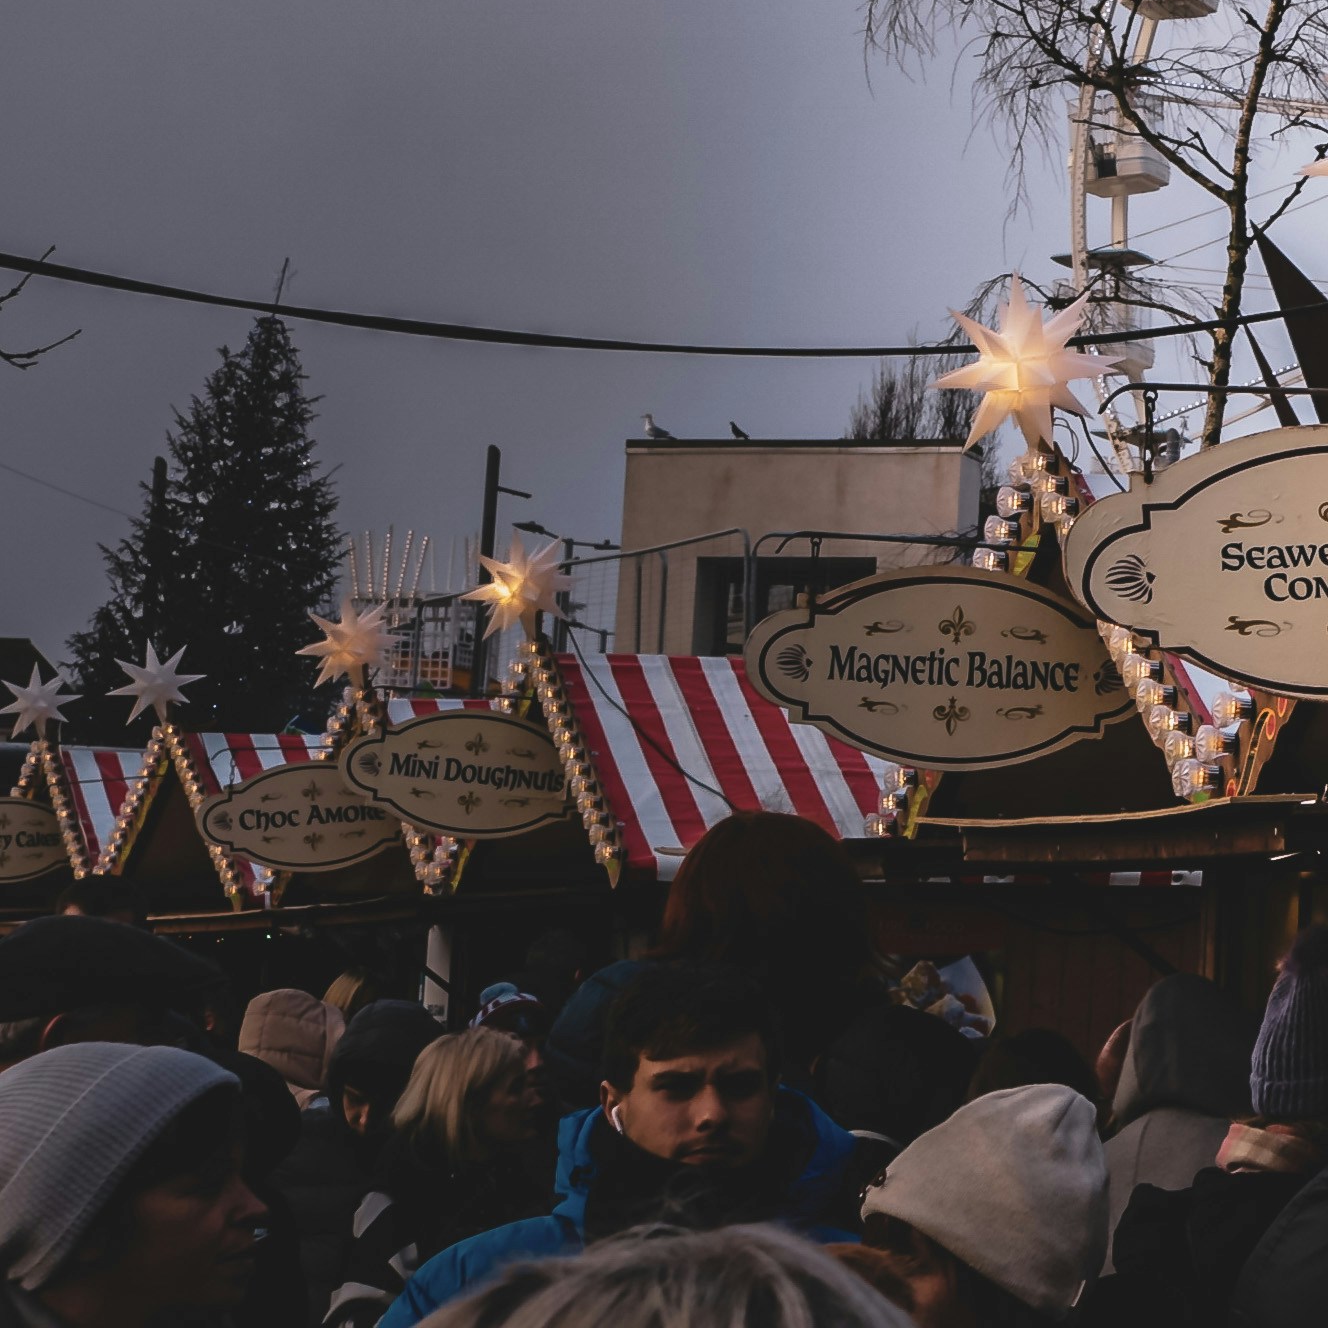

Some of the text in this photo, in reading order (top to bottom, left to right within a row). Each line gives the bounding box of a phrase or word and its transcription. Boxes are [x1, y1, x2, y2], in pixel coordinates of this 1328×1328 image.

[827, 645, 1080, 692] Magnetic Balance
[388, 752, 565, 793] Mini Doughnuts
[239, 809, 300, 833] Choc
